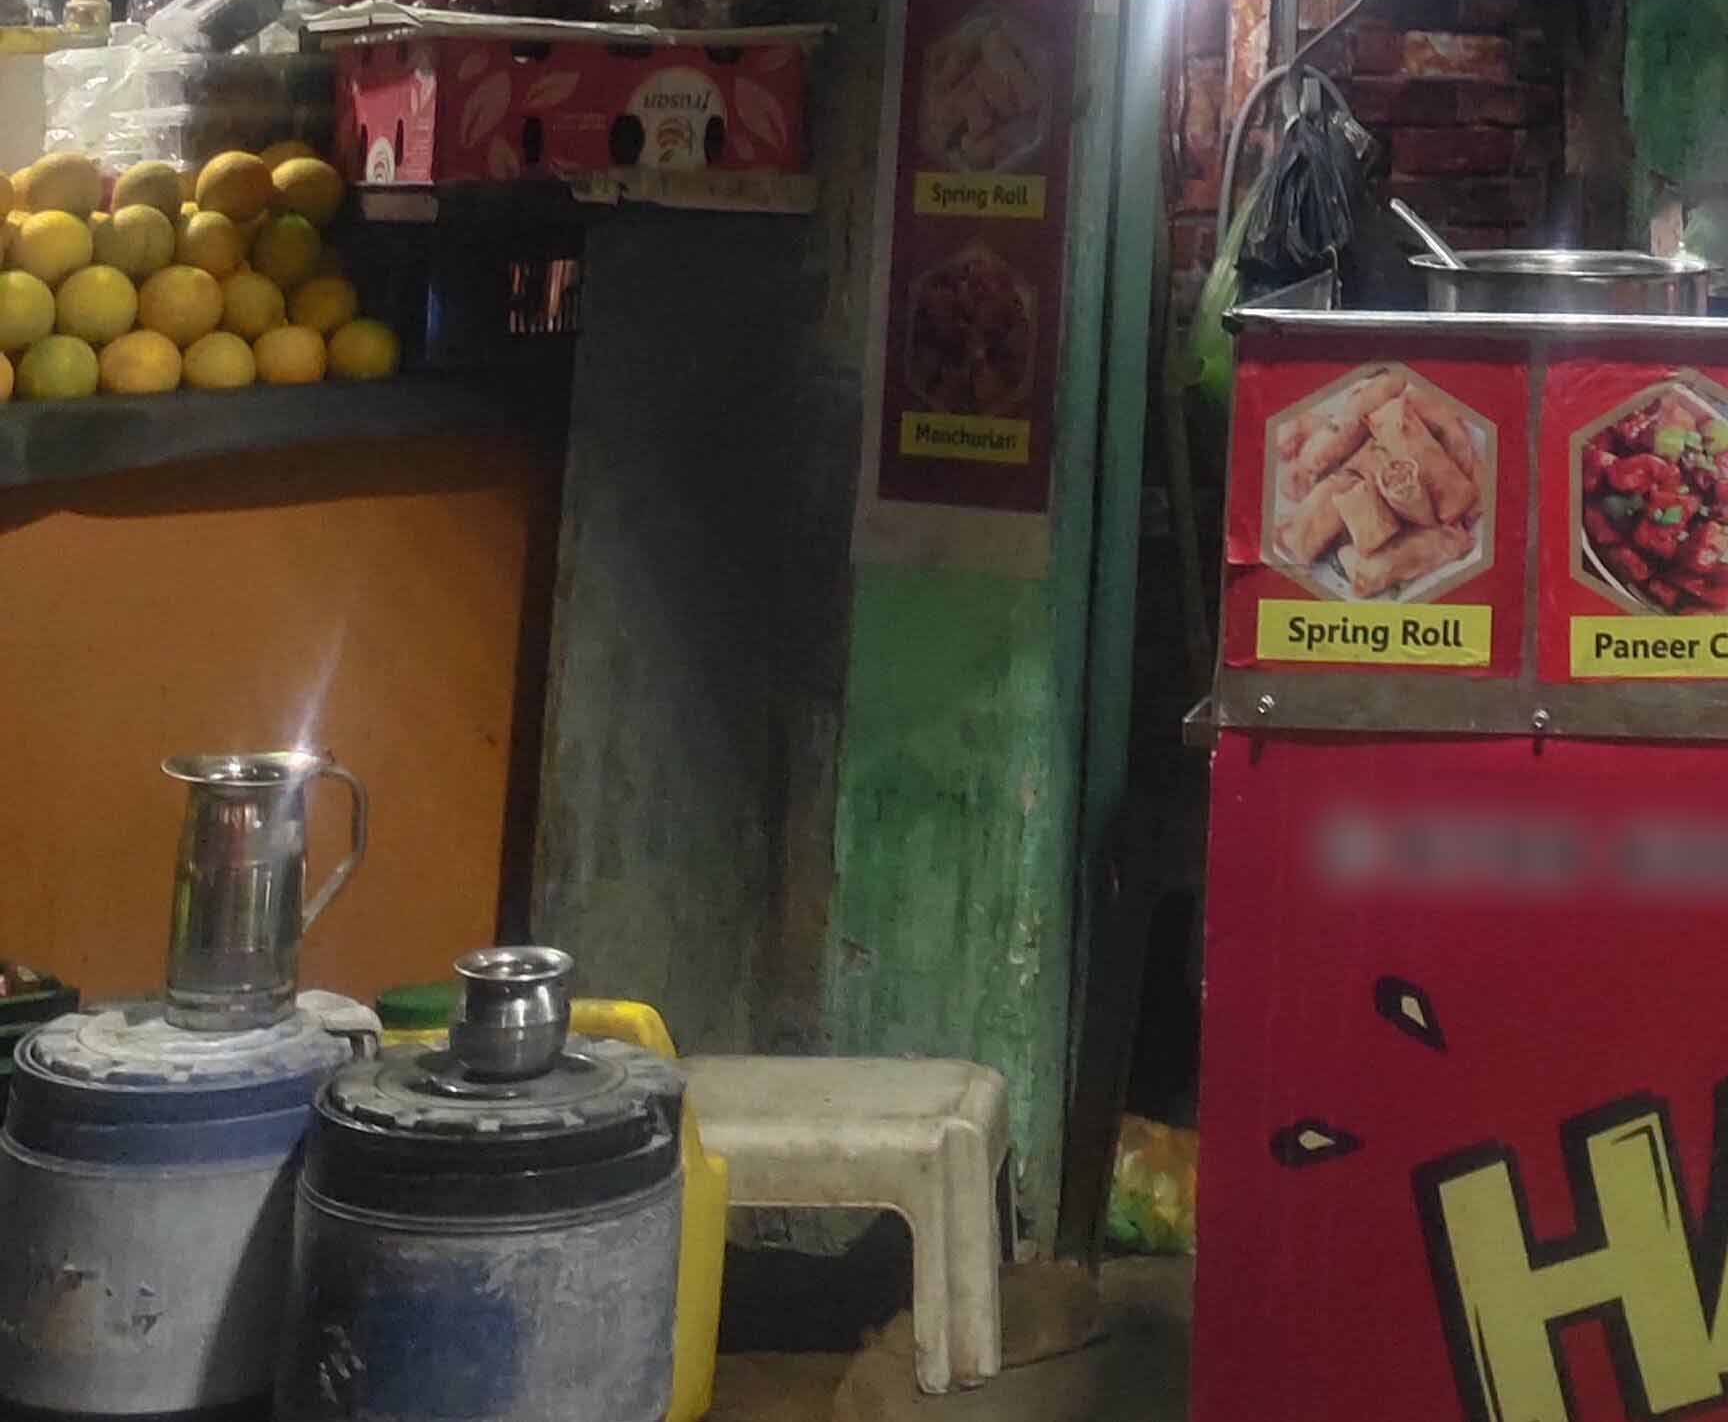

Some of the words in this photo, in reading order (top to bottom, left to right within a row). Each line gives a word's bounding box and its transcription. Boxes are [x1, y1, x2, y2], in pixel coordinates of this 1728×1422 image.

[930, 181, 989, 210] Spring
[993, 183, 1029, 205] Roll
[1288, 616, 1390, 653] Spring
[1401, 619, 1463, 648] Roll
[1594, 632, 1700, 659] Paneer
